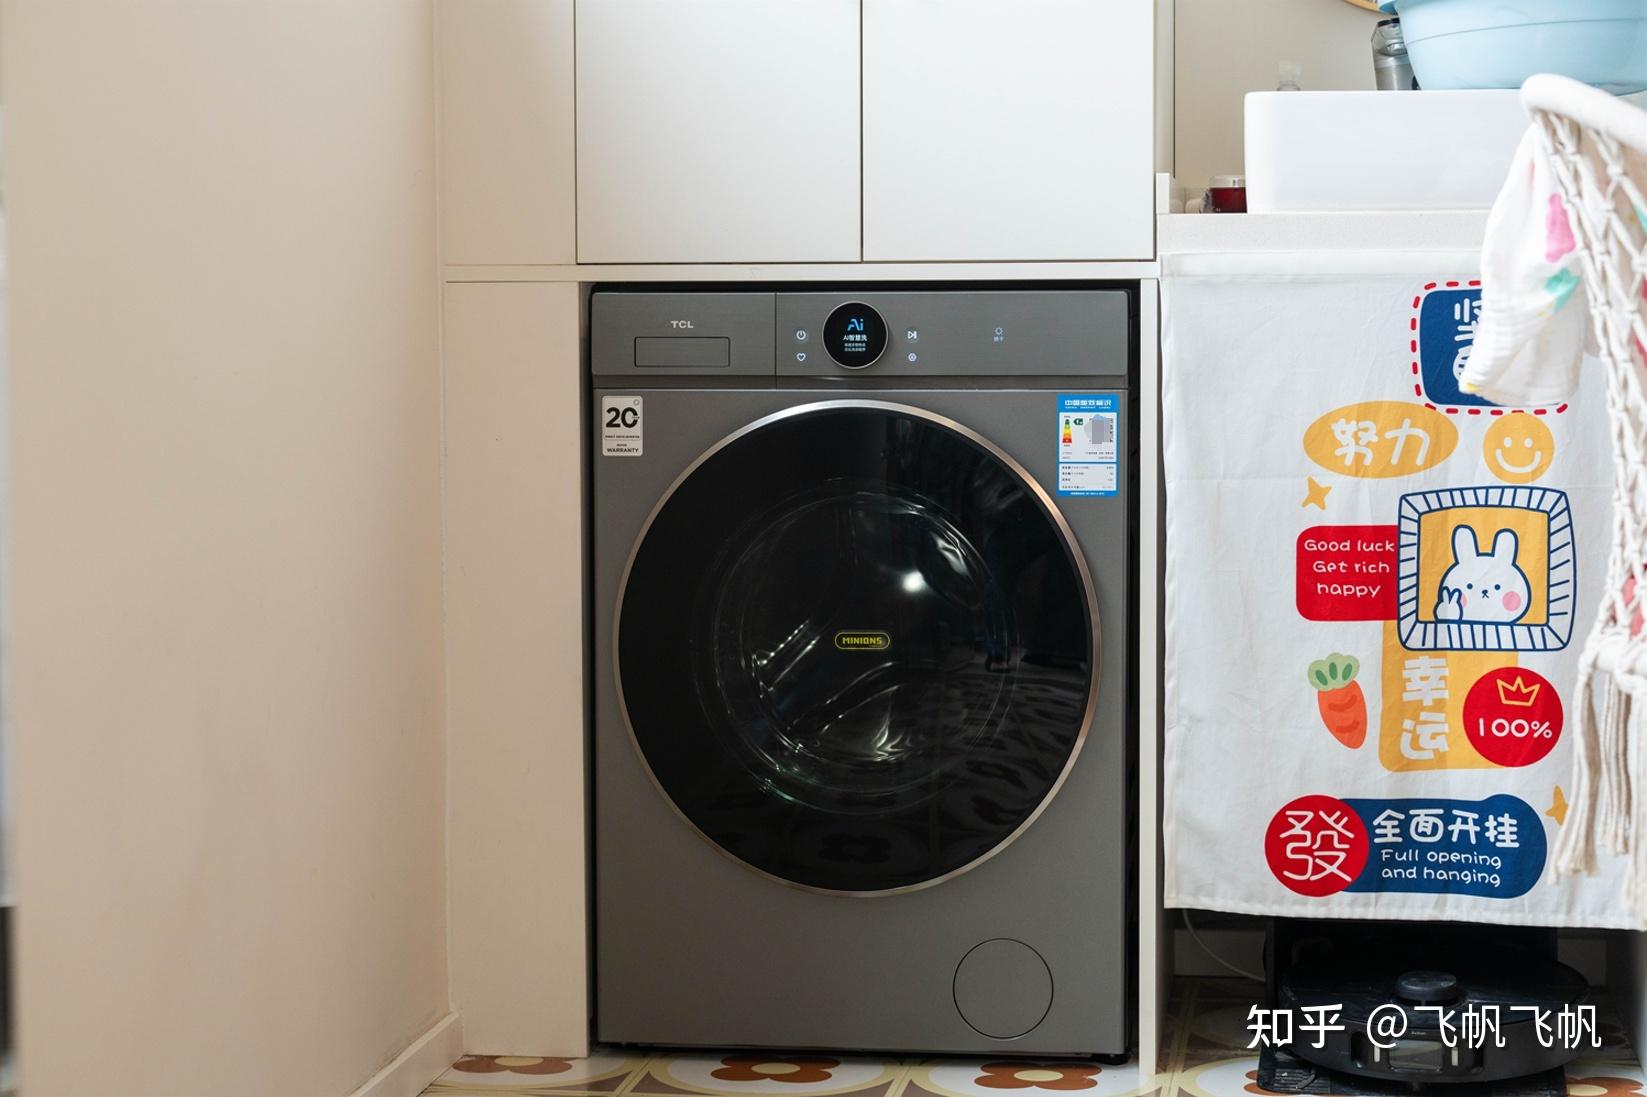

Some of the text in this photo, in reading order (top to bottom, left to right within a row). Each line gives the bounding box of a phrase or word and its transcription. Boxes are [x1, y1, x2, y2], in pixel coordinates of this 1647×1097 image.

[671, 320, 694, 329] TCL
[1331, 418, 1430, 466] 努力
[1304, 539, 1395, 552] Good luck
[1312, 560, 1391, 573] Get rich
[1317, 582, 1381, 598] happy
[842, 636, 882, 645] MINIONS
[1400, 655, 1449, 760] 幸运
[1478, 717, 1553, 739] 100%
[1372, 808, 1520, 848] 全面开挂
[1279, 810, 1355, 882] 發
[1380, 848, 1502, 870] Full opening
[1381, 866, 1502, 888] and hanging
